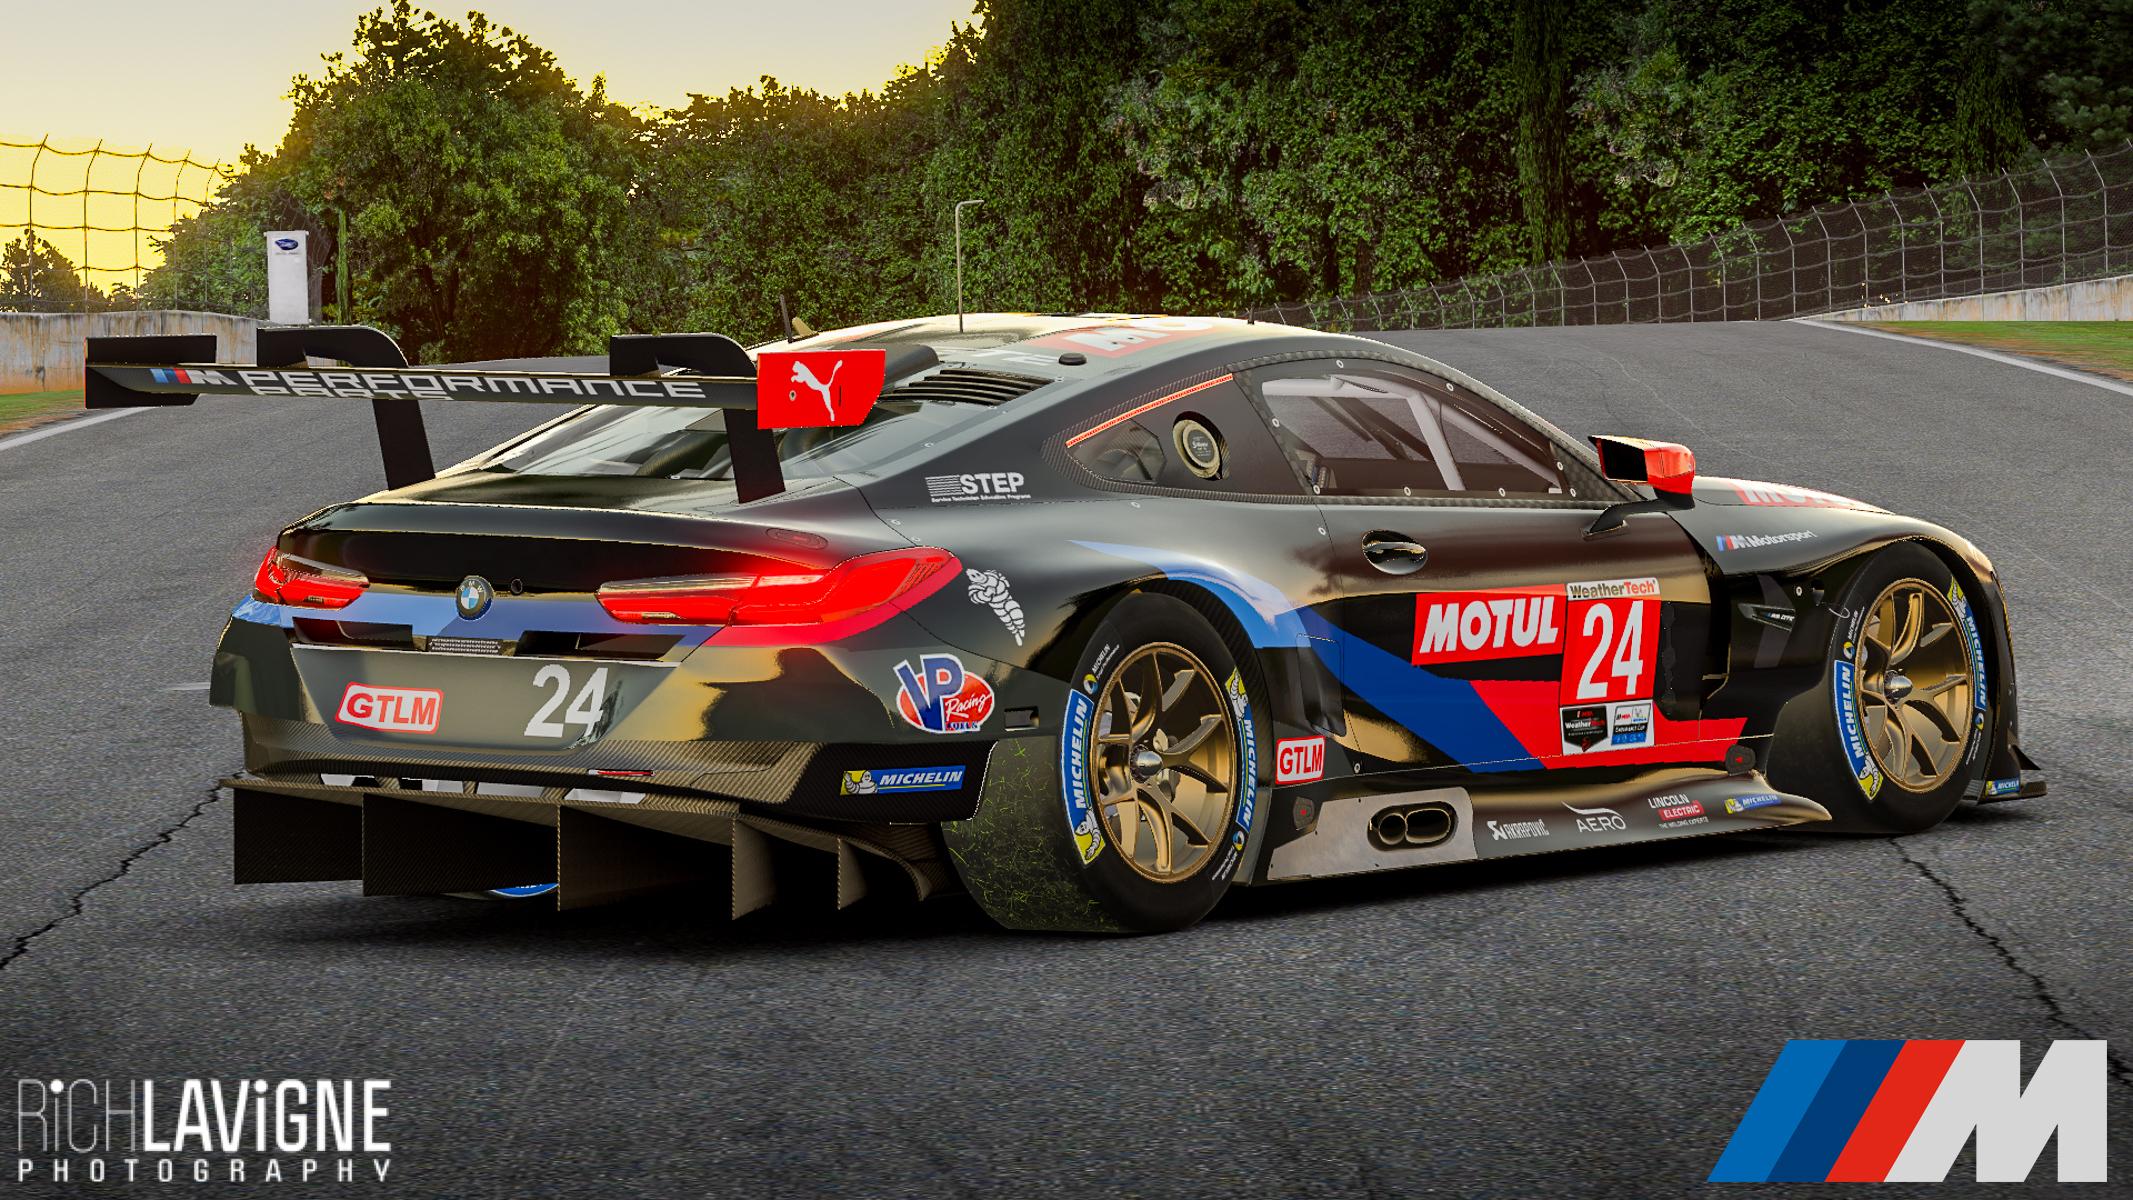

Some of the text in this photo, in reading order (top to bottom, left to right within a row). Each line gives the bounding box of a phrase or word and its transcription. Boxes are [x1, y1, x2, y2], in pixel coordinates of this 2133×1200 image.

[189, 369, 706, 398] M PERFORMANCE
[960, 472, 1024, 494] STEP
[1746, 530, 1818, 548] Motorsport
[1570, 581, 1655, 598] WeatherTech
[1419, 597, 1559, 654] MOTUL
[1576, 600, 1644, 700] 24
[1967, 615, 1986, 706] MICHELIN
[346, 692, 436, 726] GTLM
[524, 664, 608, 737] 24
[945, 693, 991, 721] Racing
[1842, 666, 1865, 758] MICHELIN
[1071, 698, 1088, 809] MICHELIN
[1280, 744, 1323, 775] GTLM
[880, 771, 962, 785] MICHELIN
[1243, 719, 1257, 827] MICHELIN
[1647, 793, 1690, 809] LINCOLN
[1663, 804, 1701, 818] ELECTRIC
[1741, 794, 1778, 806] MICHELIN
[1575, 815, 1626, 833] AERO
